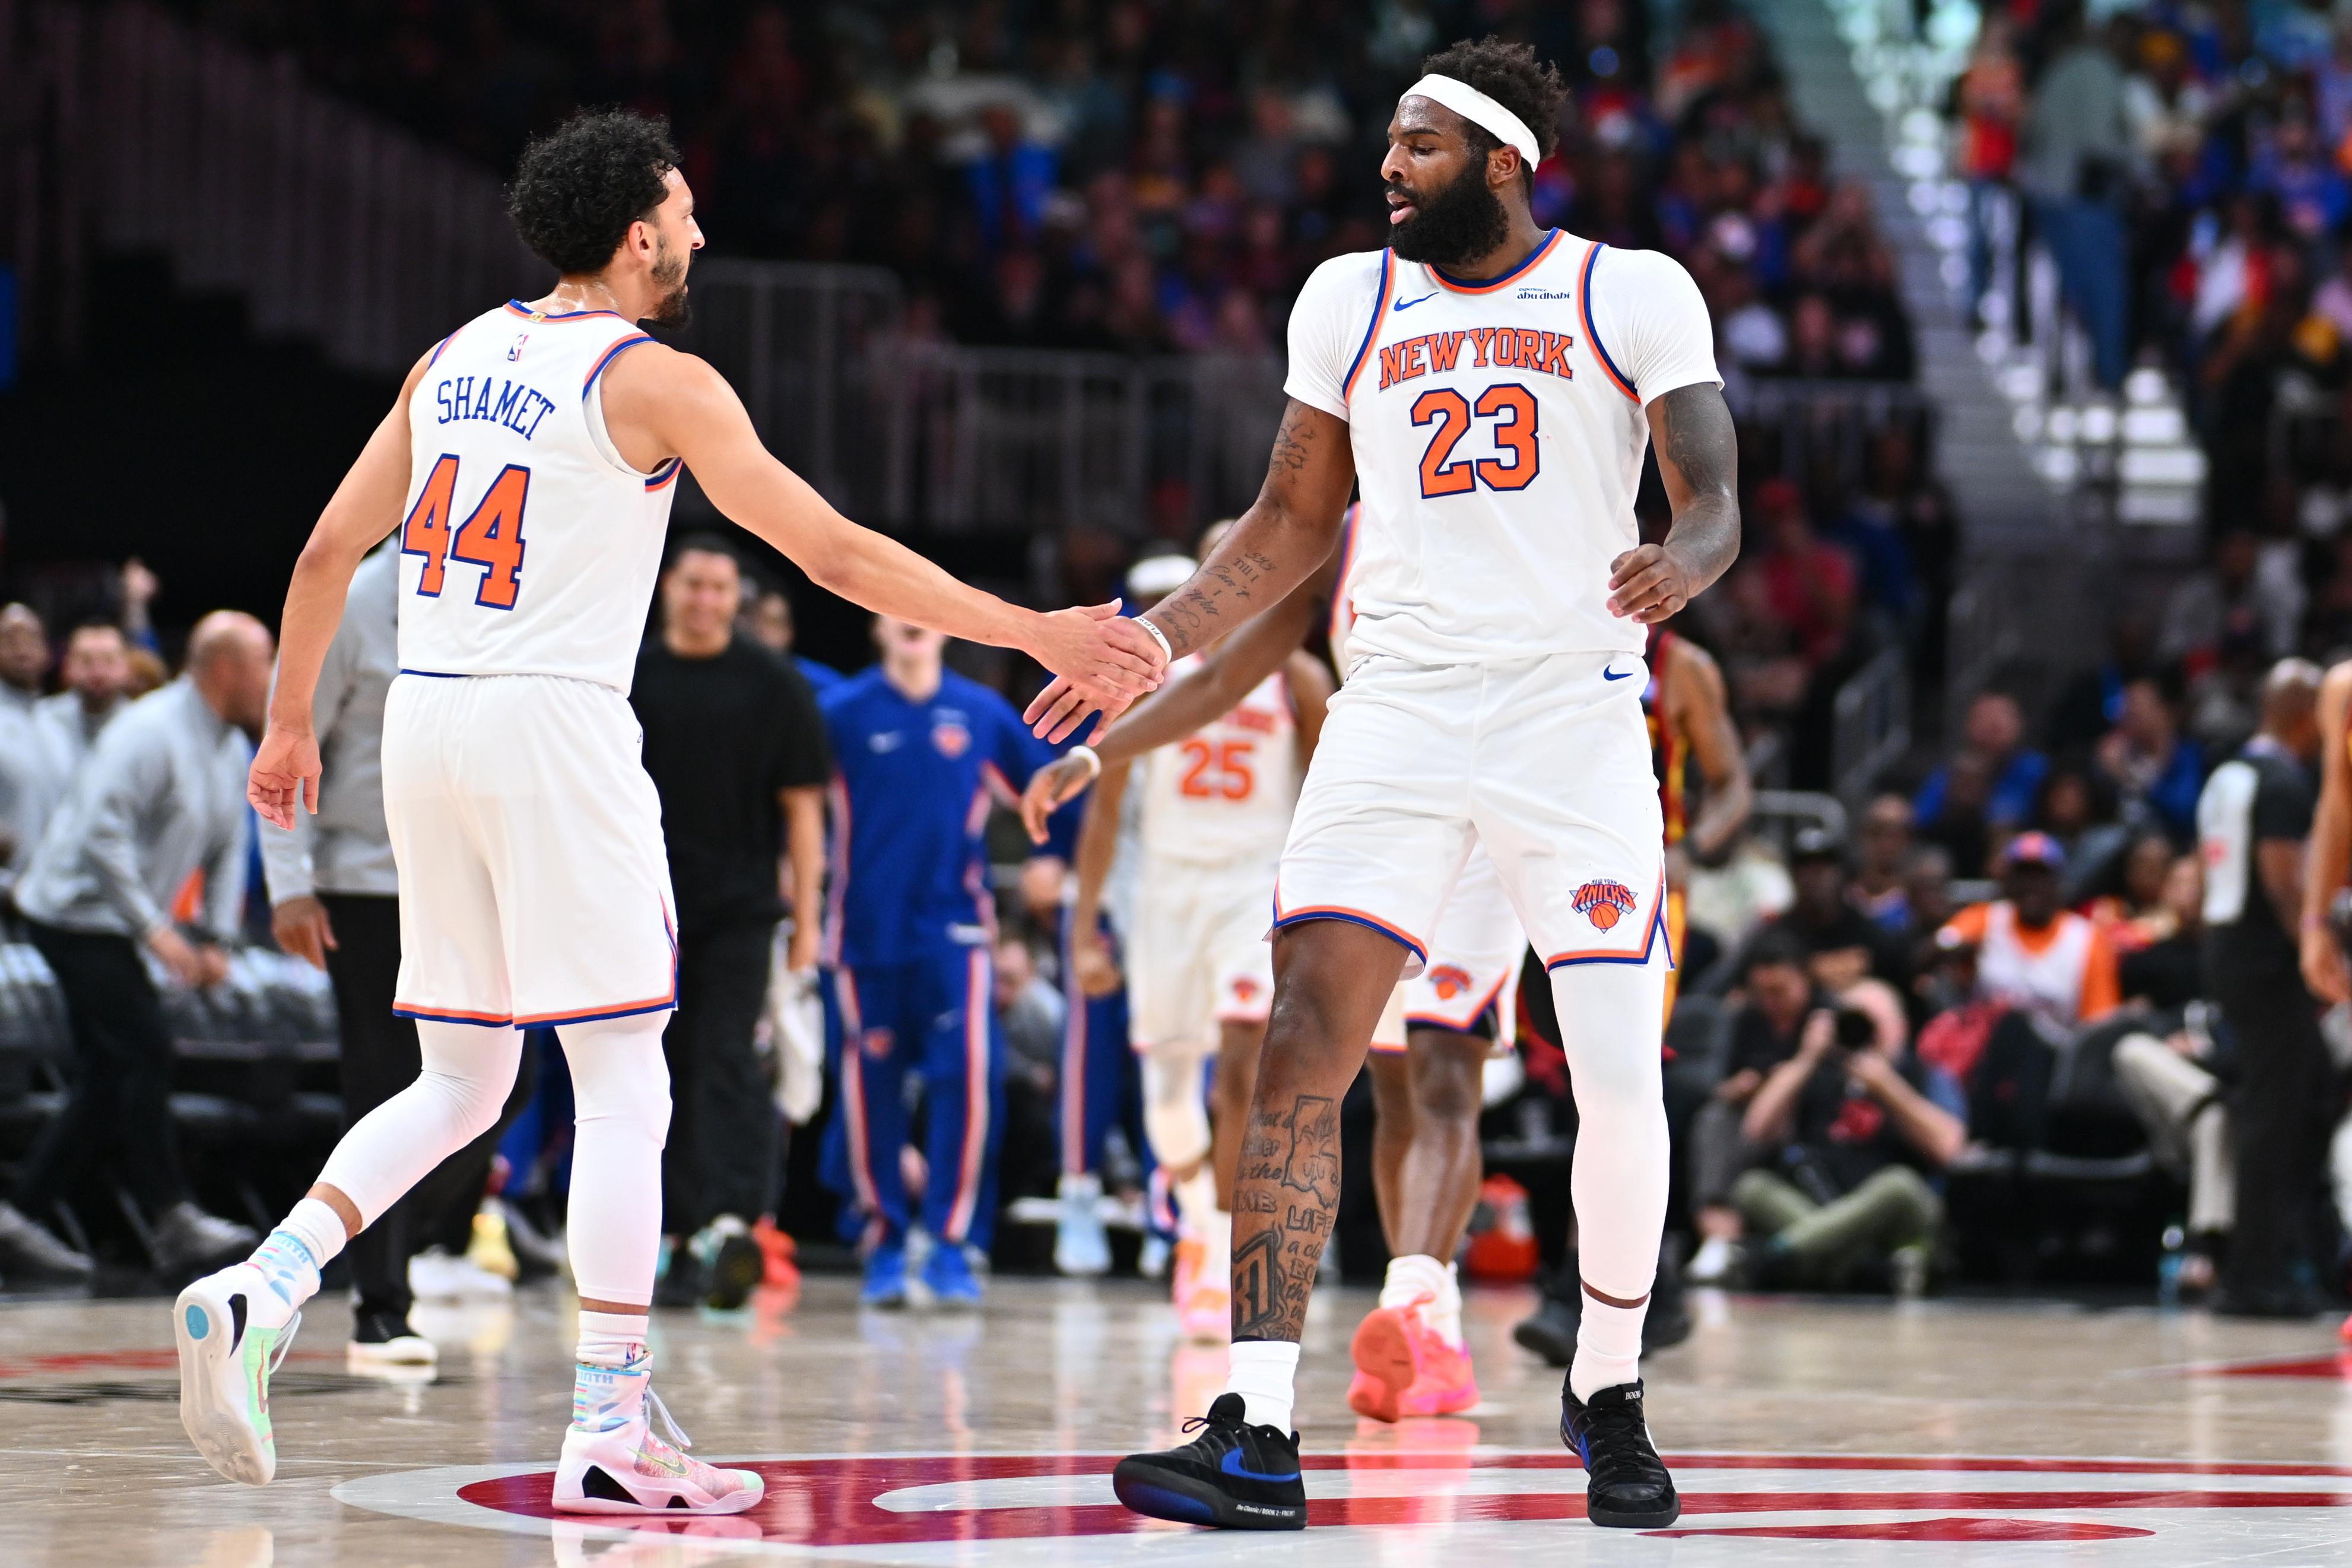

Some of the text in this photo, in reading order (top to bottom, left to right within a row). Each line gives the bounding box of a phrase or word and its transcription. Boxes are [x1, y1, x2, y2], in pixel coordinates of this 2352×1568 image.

[1379, 327, 1574, 393] NEW YORK
[437, 376, 556, 441] SHAMET
[1410, 383, 1540, 499] 23
[401, 453, 531, 611] 44
[1180, 738, 1255, 799] 25
[1572, 883, 1636, 914] KNICKS
[1626, 1391, 1641, 1400] BOOK
